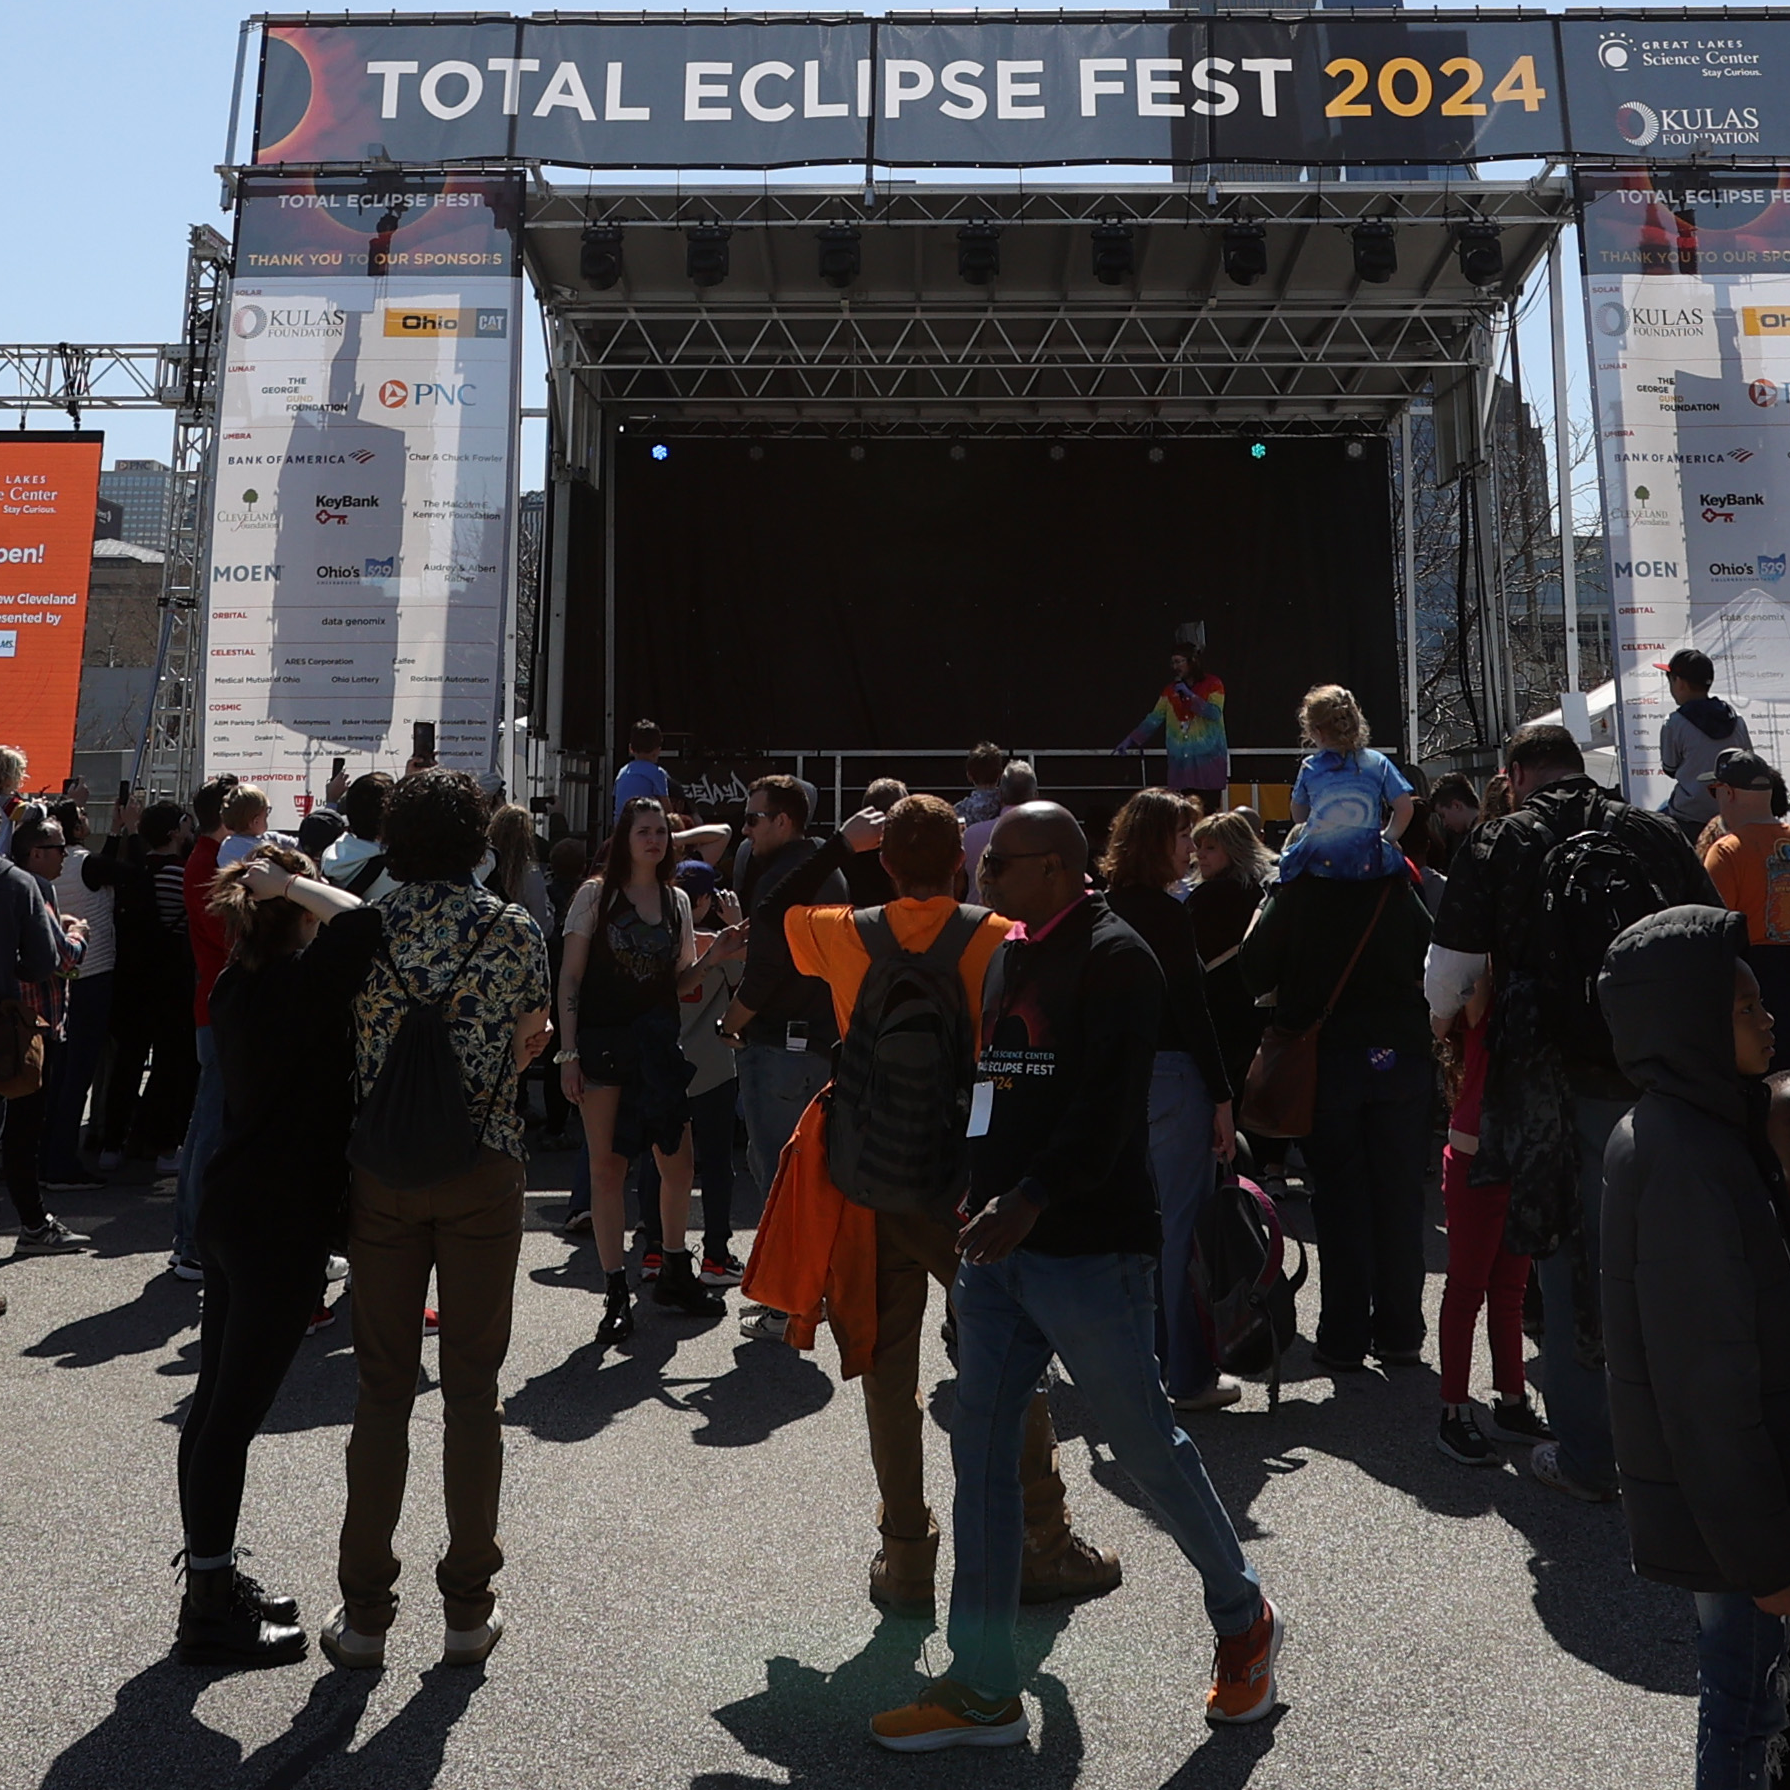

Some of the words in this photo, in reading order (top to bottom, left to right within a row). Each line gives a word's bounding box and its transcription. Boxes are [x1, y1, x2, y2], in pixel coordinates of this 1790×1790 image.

[1642, 41, 1689, 49] GREAT
[1698, 40, 1743, 48] LAKES
[1643, 53, 1700, 66] Science
[1706, 51, 1759, 64] Center
[1702, 69, 1722, 78] Stay
[366, 59, 650, 122] TOTAL
[684, 59, 1045, 123] ECLIPSE
[1080, 58, 1292, 118] FEST
[1324, 55, 1545, 118] 2024
[1661, 108, 1759, 130] KULAS
[1663, 132, 1759, 145] FOUNDATION
[279, 194, 339, 208] TOTAL
[347, 194, 426, 208] ECLIPSE
[434, 193, 481, 207] FEST
[1617, 190, 1678, 204] TOTAL
[1685, 190, 1765, 204] ECLIPSE
[248, 255, 303, 265] THANK
[310, 254, 342, 265] YOU
[348, 255, 367, 264] TO
[374, 254, 409, 264] OUR
[414, 253, 502, 264] SPONSORS
[1600, 251, 1652, 263] THANK
[1659, 251, 1691, 263] YOU
[1697, 251, 1717, 262] TO
[1723, 251, 1756, 262] OUR
[270, 310, 344, 326] KULAS
[402, 316, 457, 329] Ohio
[1633, 308, 1703, 325] KULAS
[479, 316, 504, 330] CAT
[268, 328, 343, 338] FOUNDATION
[1633, 327, 1703, 337] FOUNDATION
[413, 383, 476, 406] PNC
[287, 404, 347, 412] FOUNDATION
[228, 457, 263, 465] BANK
[267, 456, 283, 464] OF
[285, 455, 345, 464] AMERICA
[472, 454, 502, 462] Fowler
[1614, 454, 1648, 462] BANK
[1652, 454, 1664, 462] OF
[1667, 454, 1724, 463] AMERICA
[10, 487, 57, 500] Center
[316, 495, 378, 510] KeyBank
[423, 500, 440, 508] The
[1700, 494, 1763, 508] KeyBank
[3, 506, 20, 515] Stay
[413, 512, 445, 520] Kenney
[449, 512, 500, 520] Foundation
[213, 565, 280, 582] MOEN
[317, 566, 359, 578] Ohio's
[367, 565, 393, 576] 529
[424, 564, 456, 573] Audrey
[469, 564, 495, 572] Albert
[1615, 561, 1677, 578] MOEN
[1710, 563, 1753, 575] Ohio's
[1761, 562, 1784, 574] 529
[17, 594, 76, 604] Cleveland
[46, 613, 61, 625] by
[345, 618, 385, 627] genomix
[308, 658, 353, 666] Corporation
[352, 676, 379, 684] Lottery
[1025, 1052, 1055, 1060] CENTER
[989, 1062, 1023, 1073] ECLIPSE
[1026, 1064, 1055, 1075] FEST
